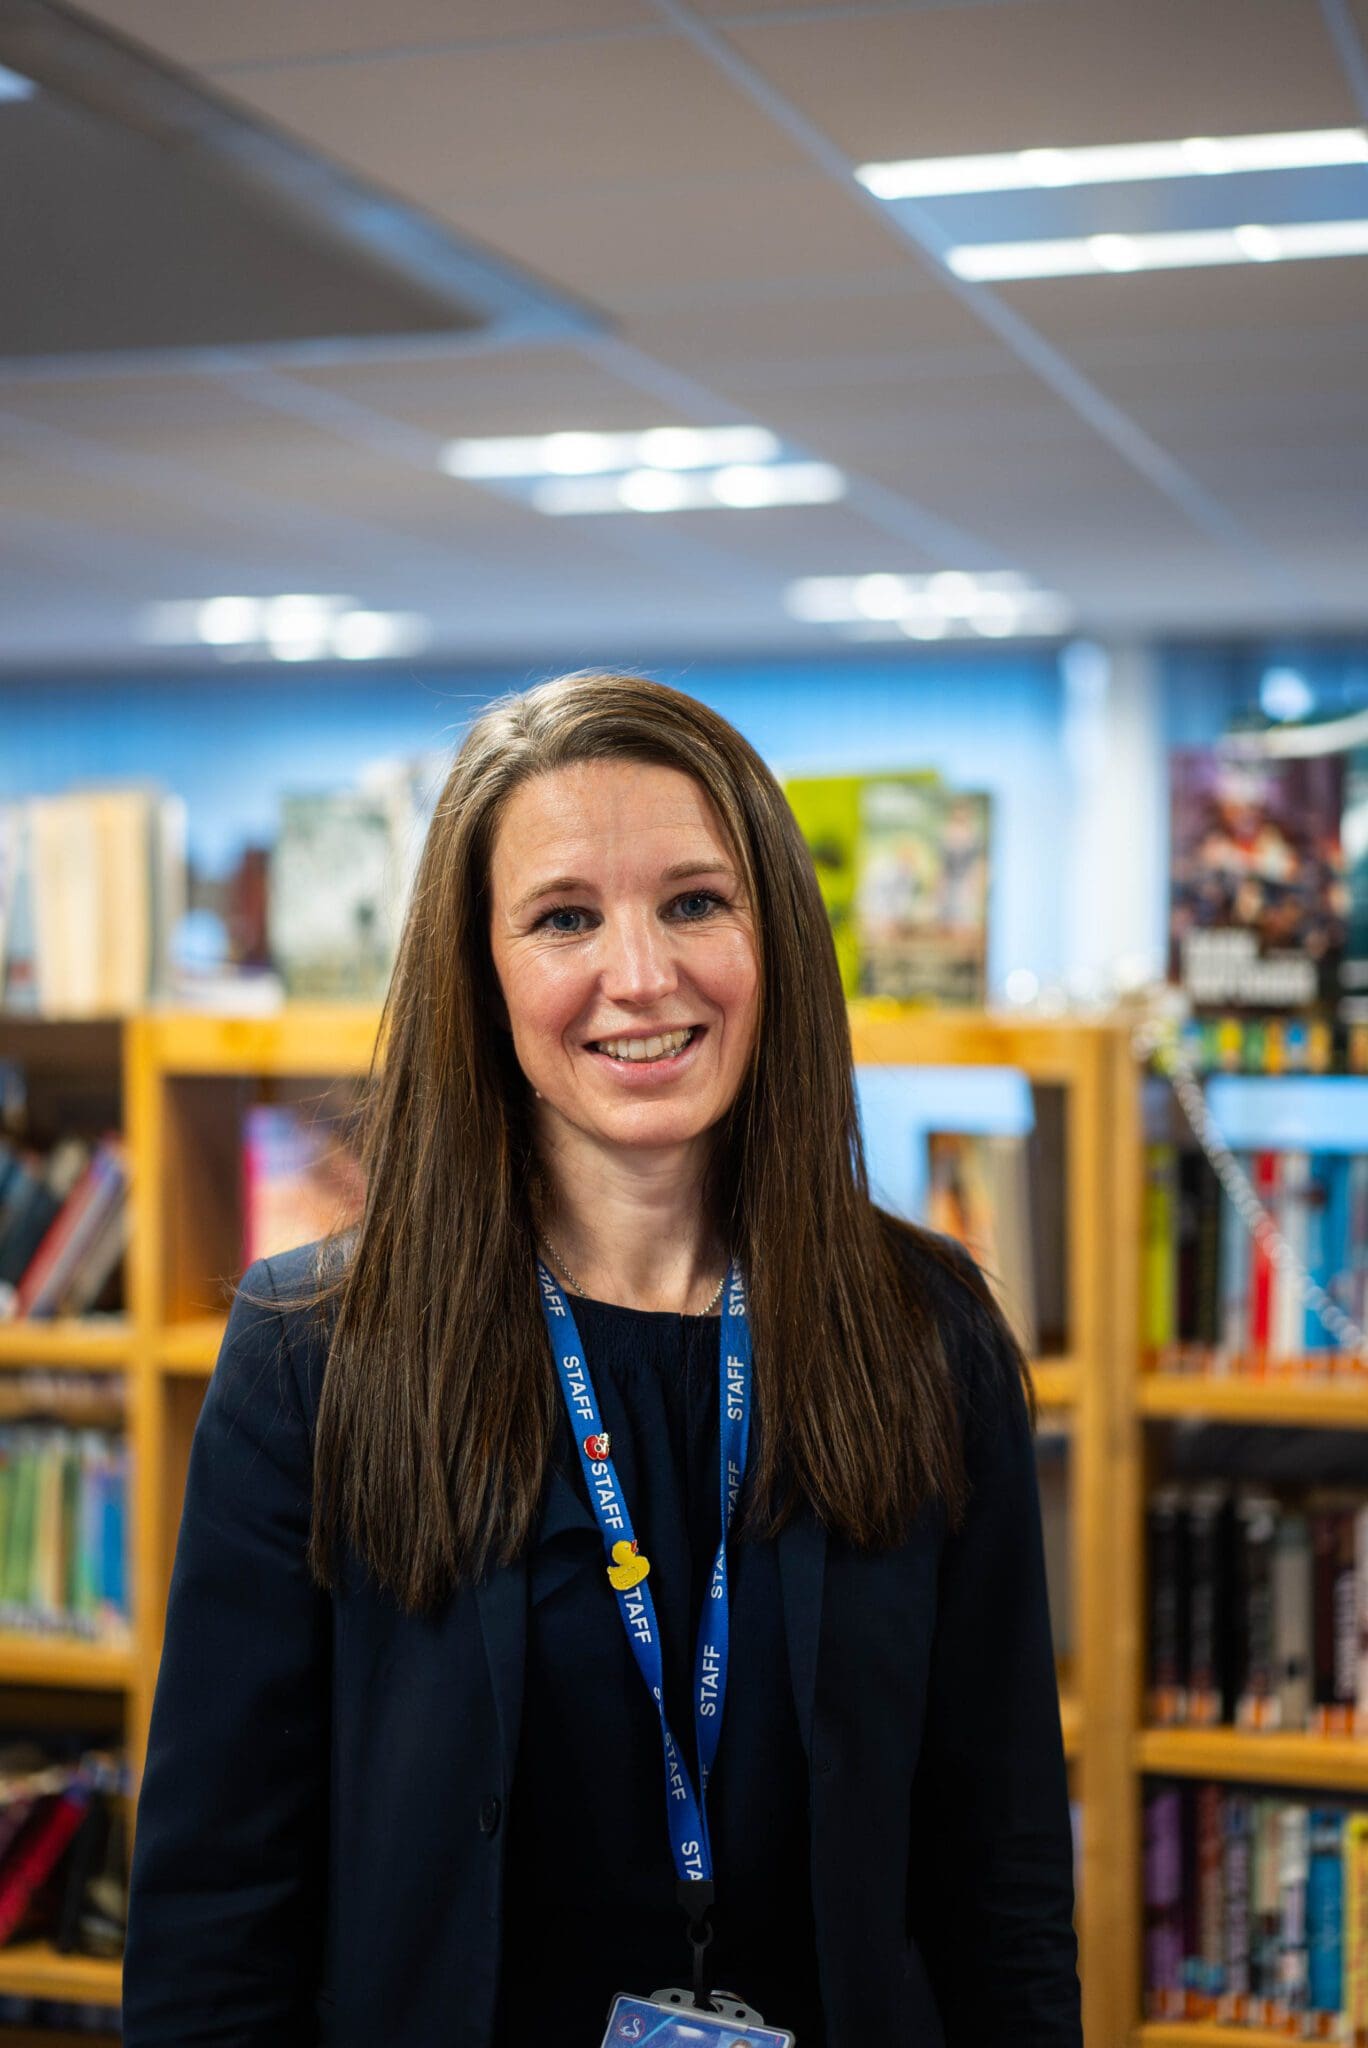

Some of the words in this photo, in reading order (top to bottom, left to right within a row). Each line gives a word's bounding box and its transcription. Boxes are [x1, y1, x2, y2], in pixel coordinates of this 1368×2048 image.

[563, 1355, 594, 1420] STAFF
[727, 1355, 745, 1421] STAFF
[591, 1462, 624, 1529] STAFF
[727, 1459, 740, 1528] TAFF
[624, 1586, 652, 1643] TAFF
[700, 1644, 720, 1717] STAFF
[681, 1841, 703, 1880] STA
